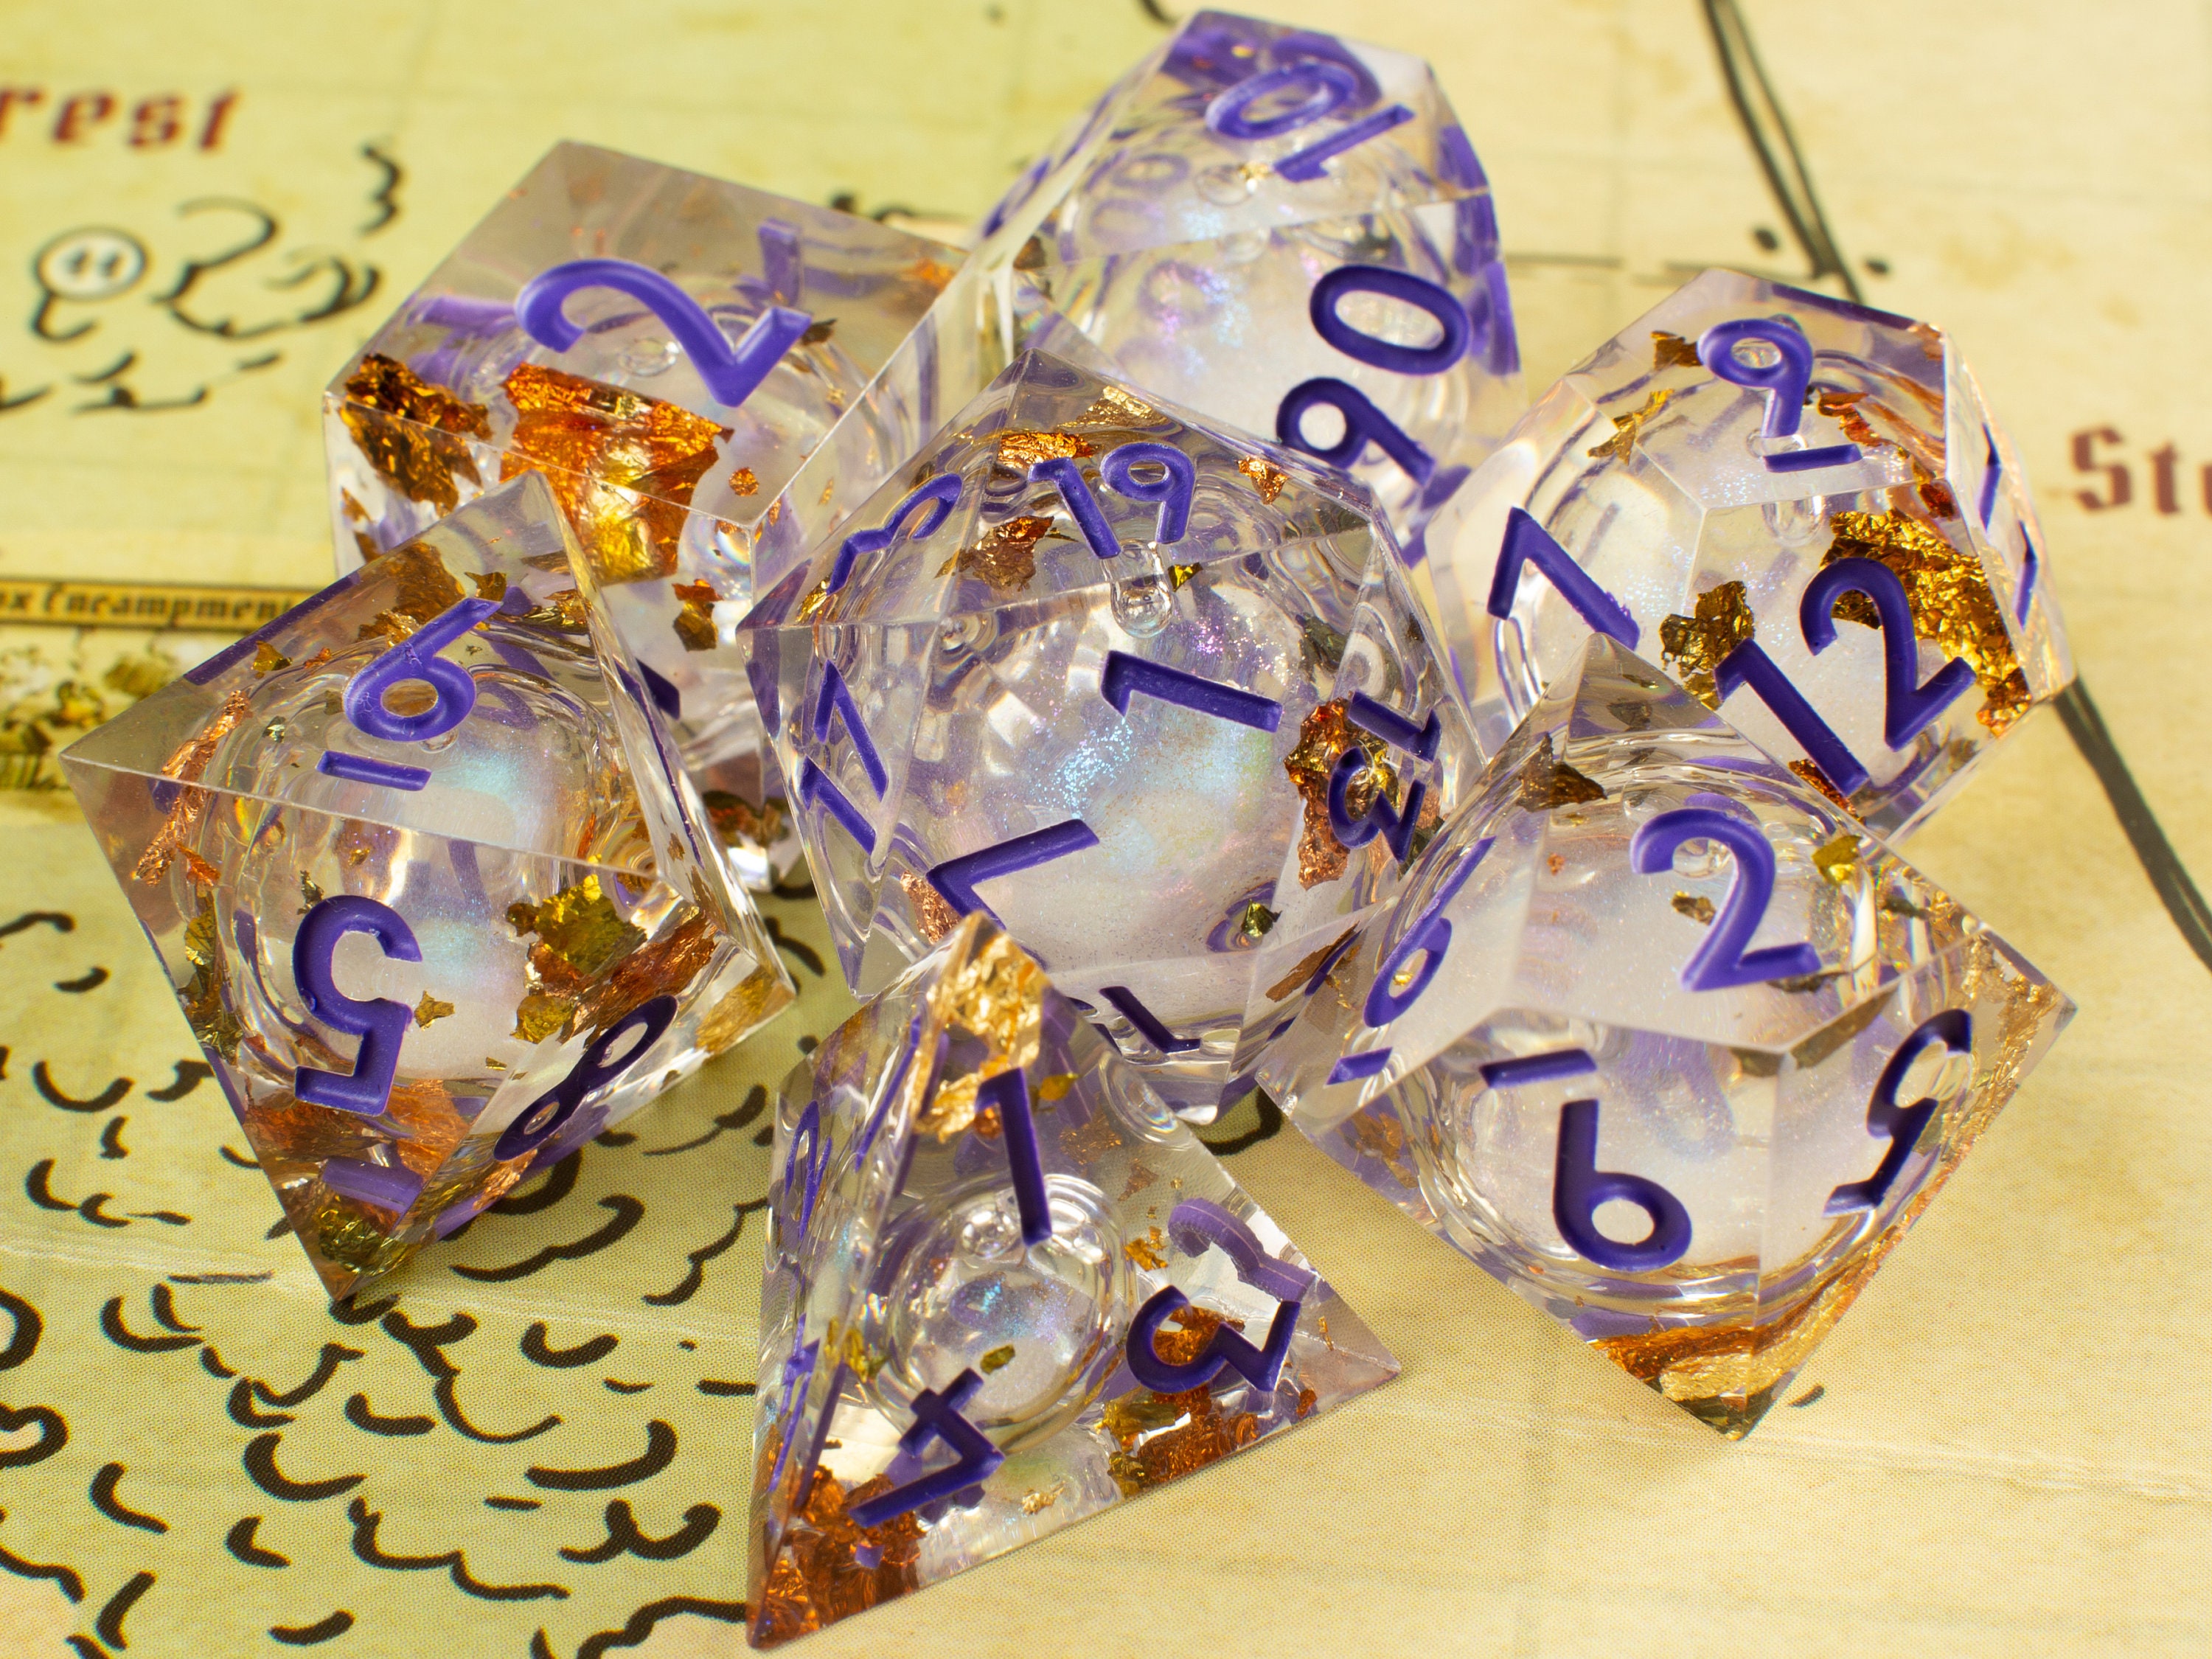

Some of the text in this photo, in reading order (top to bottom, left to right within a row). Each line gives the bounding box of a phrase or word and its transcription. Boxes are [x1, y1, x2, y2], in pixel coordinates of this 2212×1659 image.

[1027, 442, 1195, 560] 19
[1714, 556, 1978, 798] 12
[1630, 808, 1823, 992] 2
[293, 895, 422, 1116] 5
[493, 994, 677, 1162] 8
[849, 1367, 1005, 1528] 4
